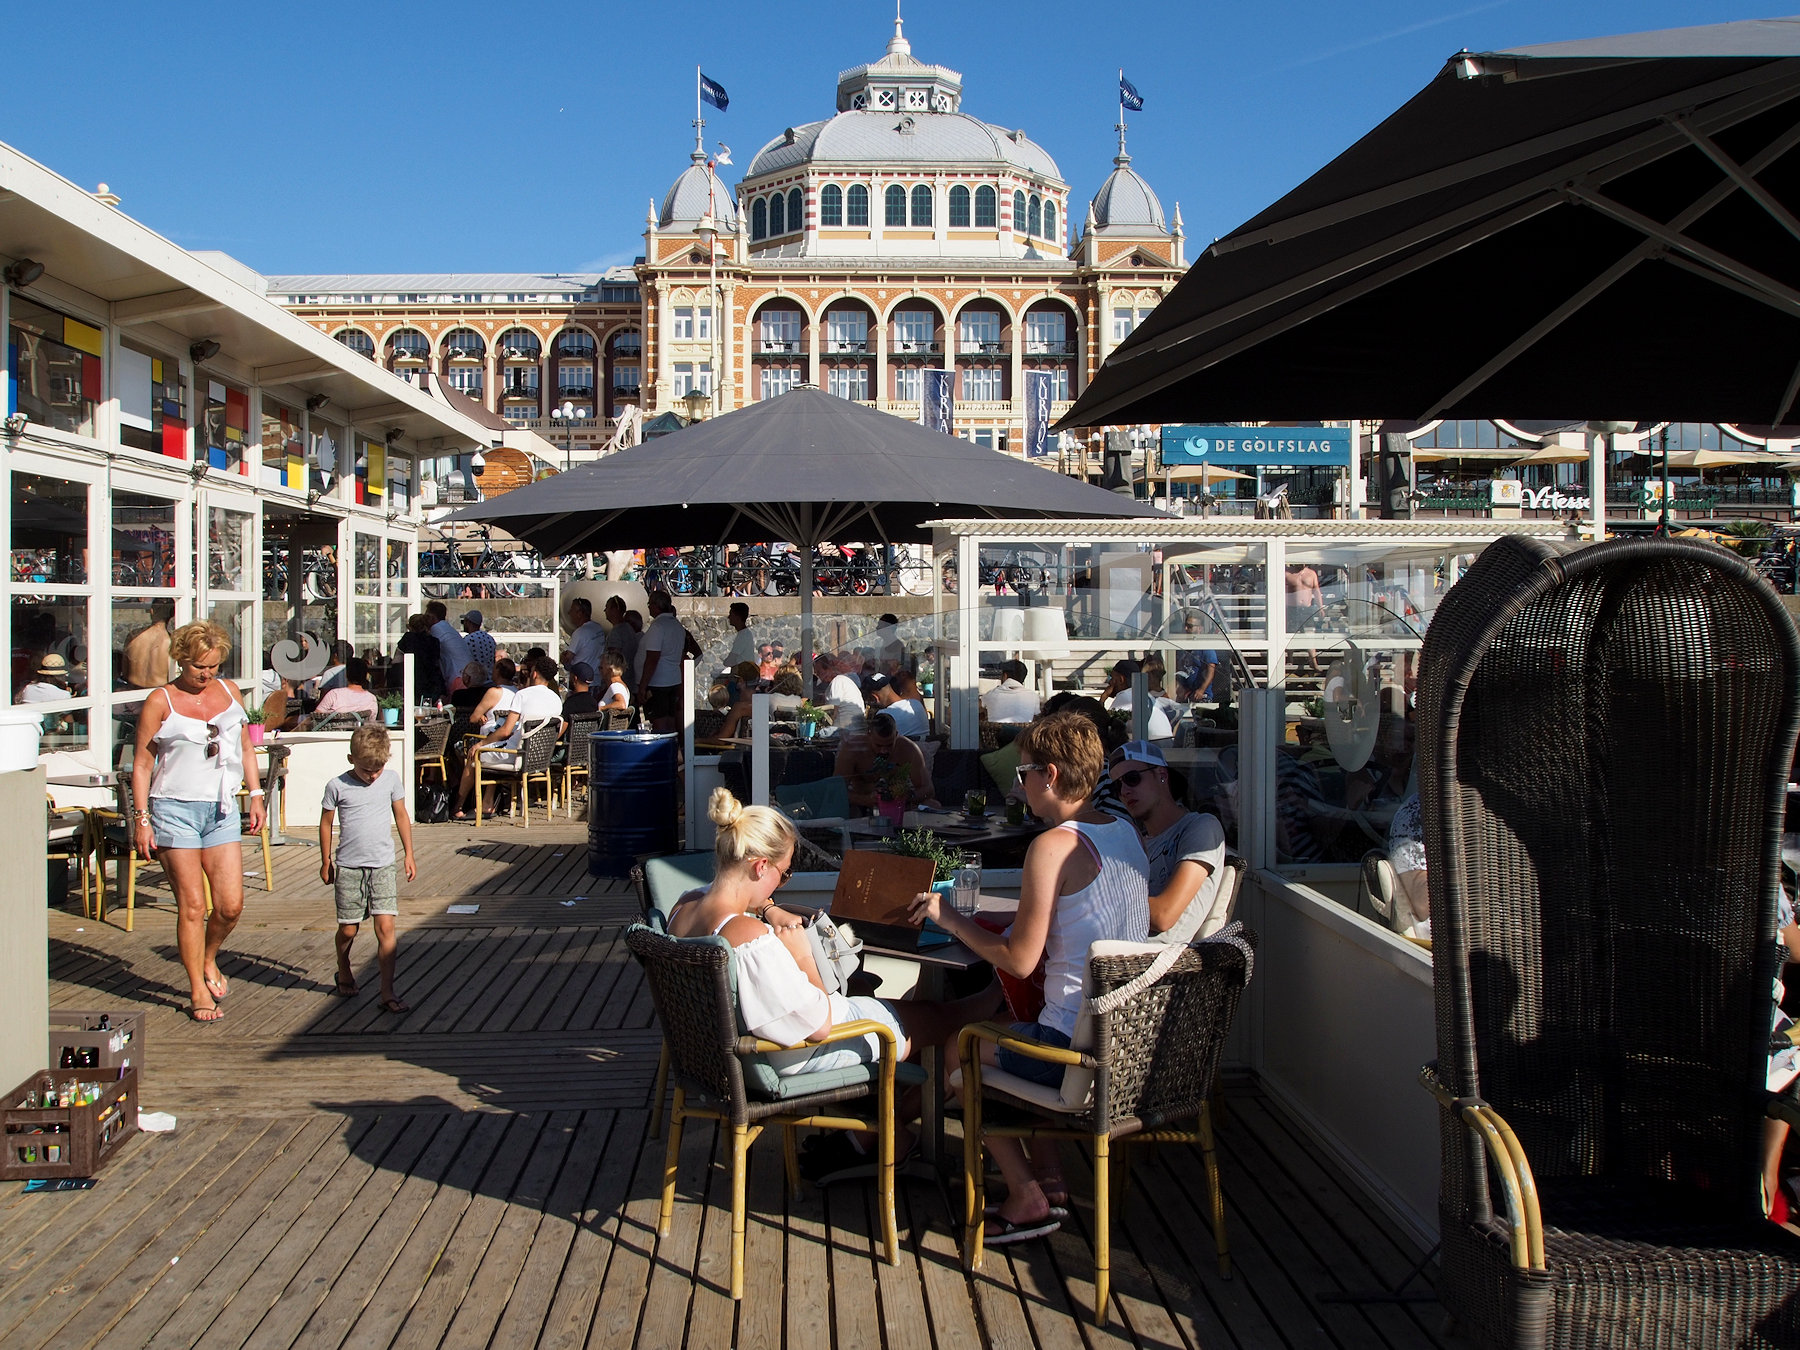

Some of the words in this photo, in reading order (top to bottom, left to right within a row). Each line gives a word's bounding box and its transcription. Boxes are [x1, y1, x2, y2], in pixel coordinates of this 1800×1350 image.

[939, 374, 950, 435] KURHA
[1036, 376, 1048, 454] KURHAUS
[1215, 440, 1236, 453] DE
[1242, 439, 1331, 453] GOLFSLAG
[1630, 489, 1720, 512] Reaurant
